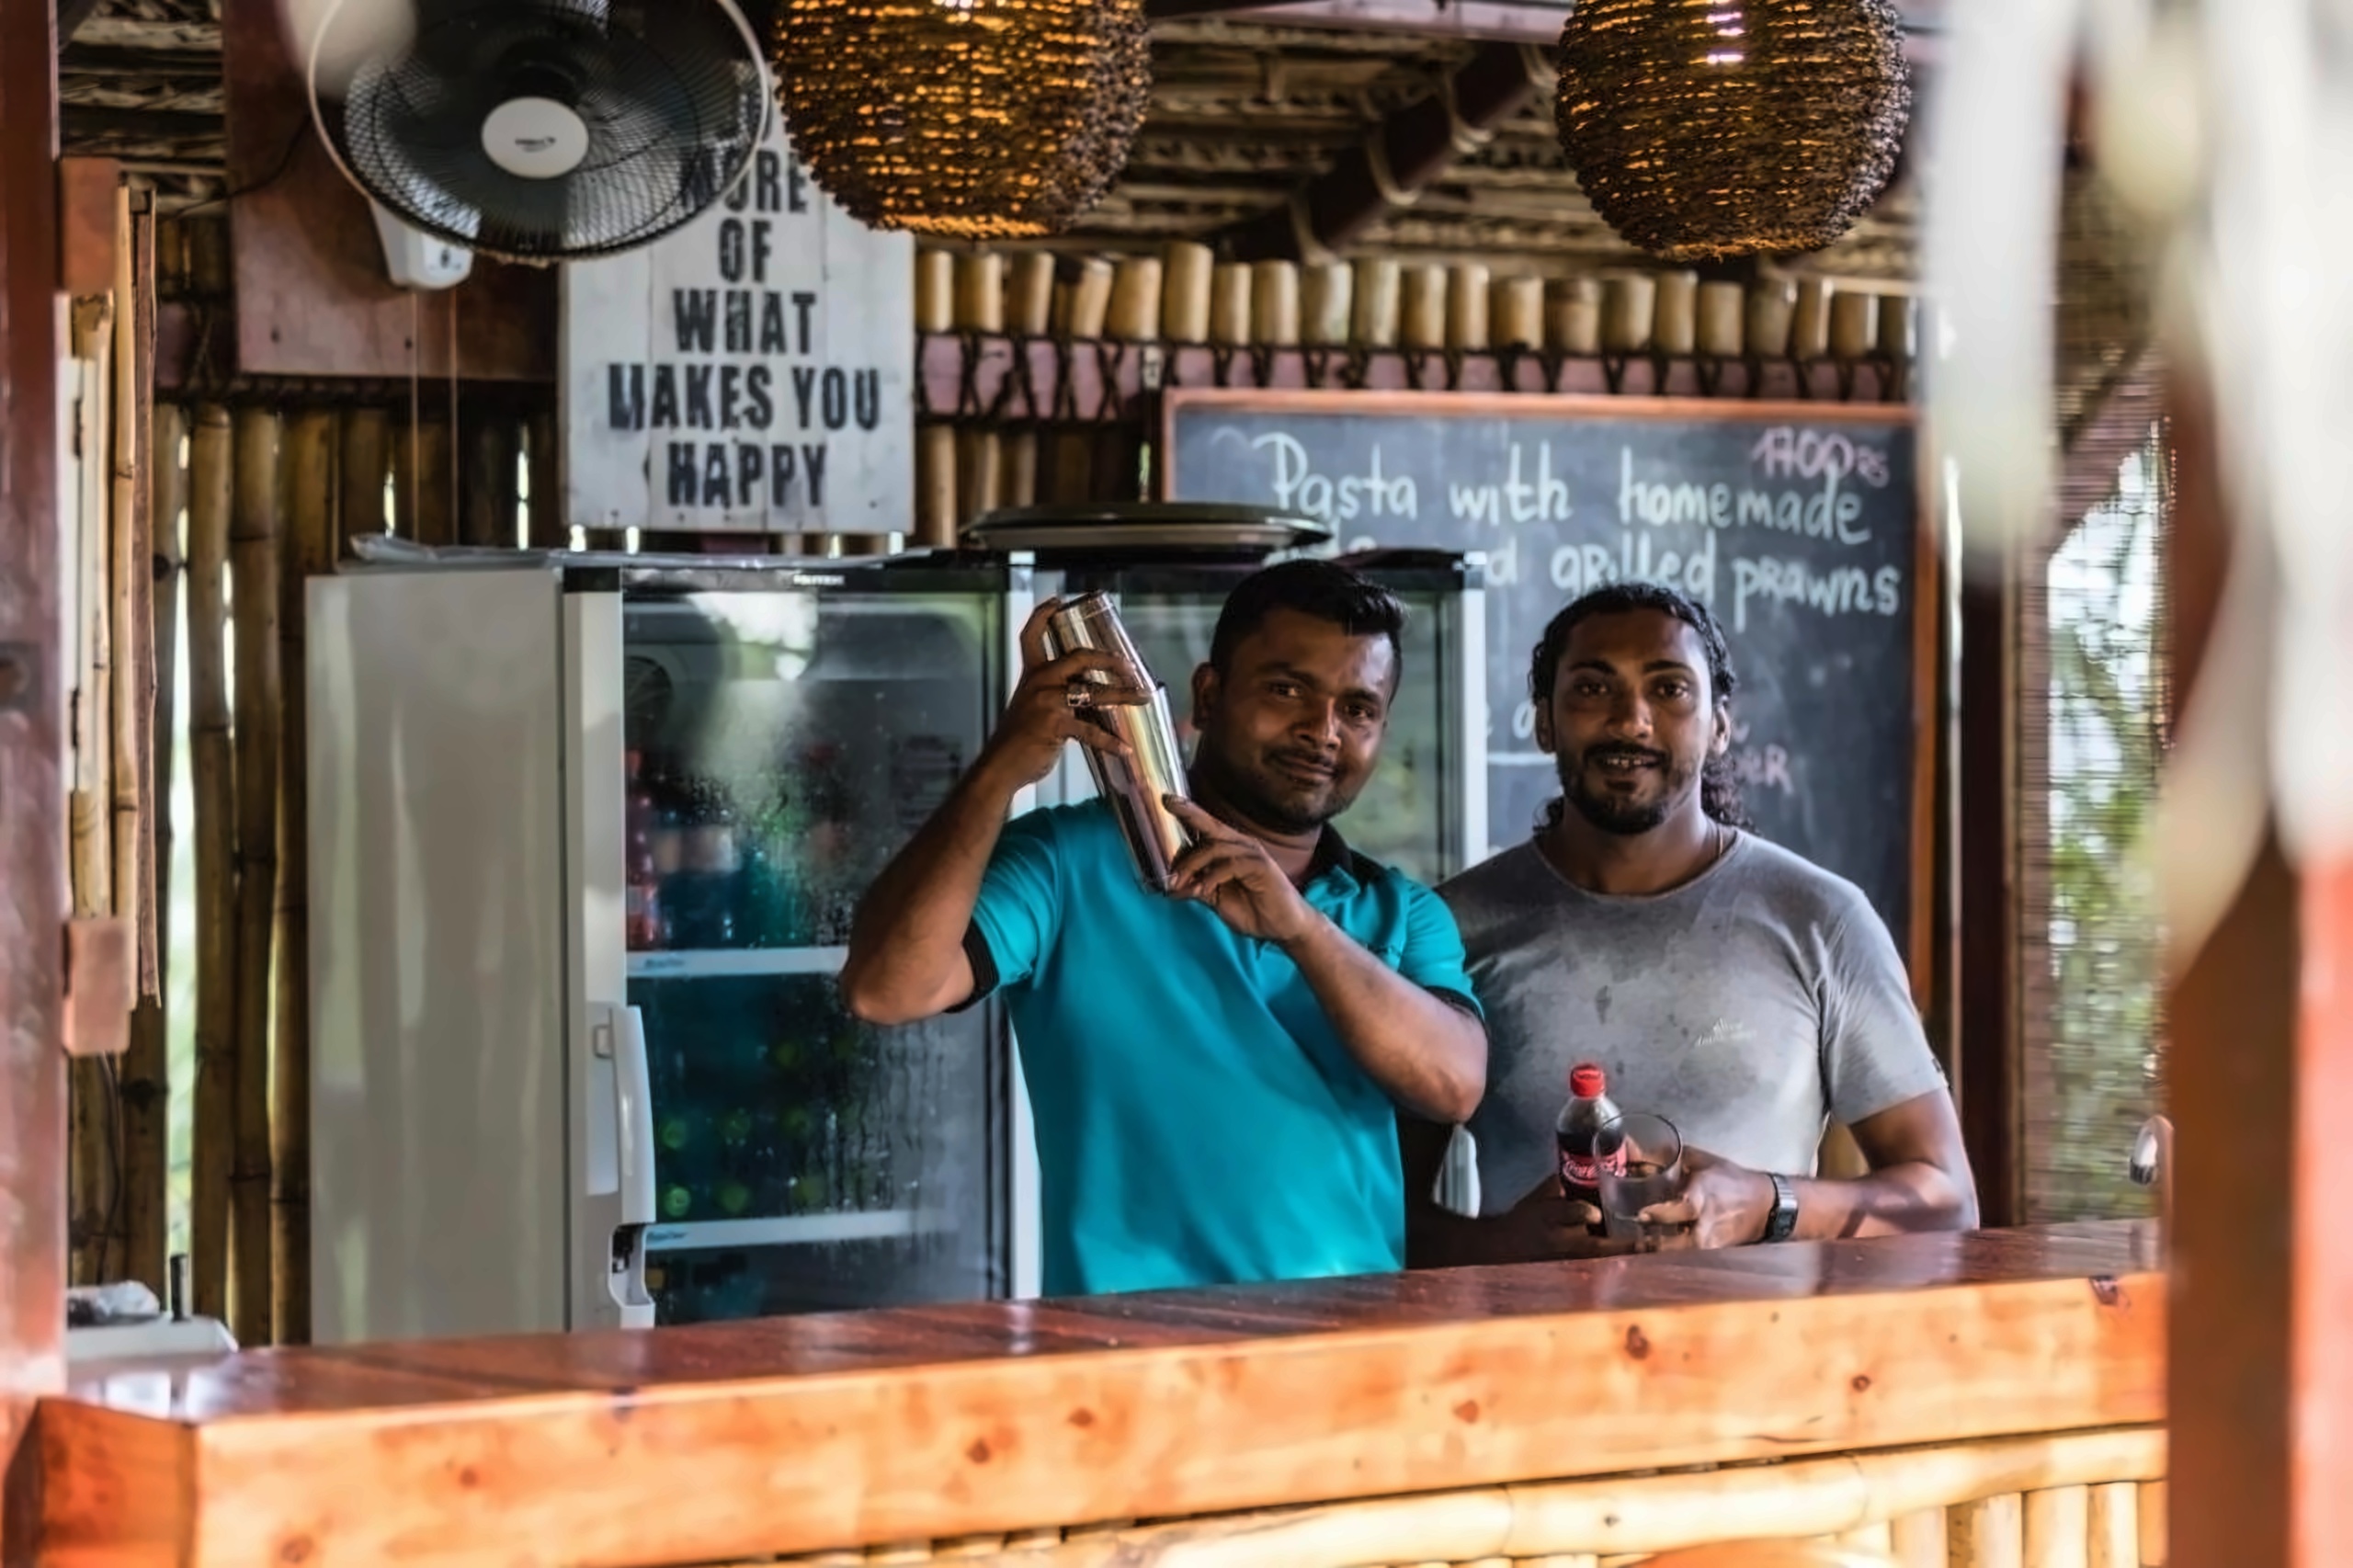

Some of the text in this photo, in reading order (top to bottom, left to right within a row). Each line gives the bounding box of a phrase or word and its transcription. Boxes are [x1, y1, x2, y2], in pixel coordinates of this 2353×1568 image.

[718, 218, 772, 283] OF
[673, 289, 816, 355] WHAT
[608, 363, 881, 431] MAKES YOU
[667, 441, 826, 507] HAPPY
[1252, 432, 1871, 545] Pasta with homemade
